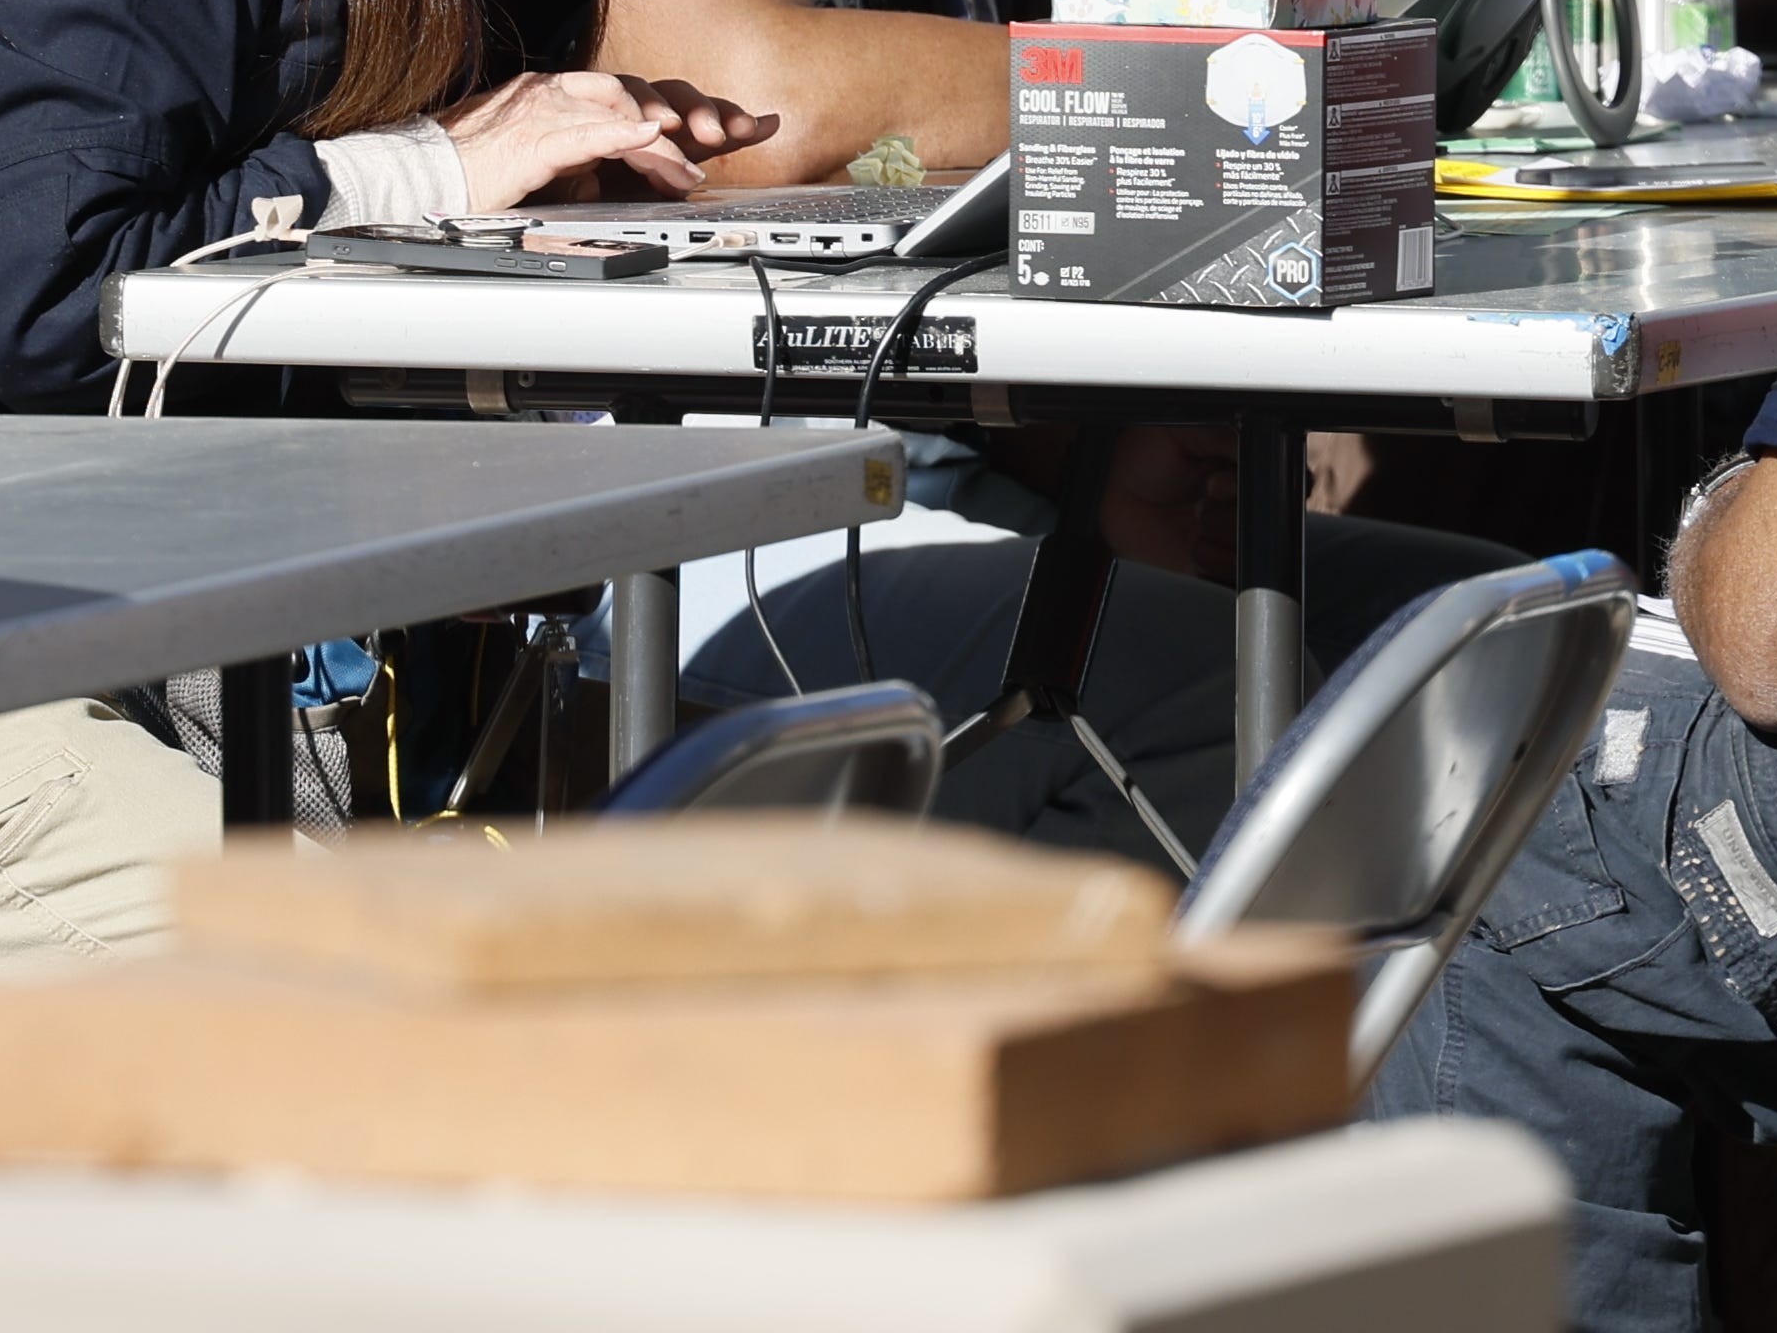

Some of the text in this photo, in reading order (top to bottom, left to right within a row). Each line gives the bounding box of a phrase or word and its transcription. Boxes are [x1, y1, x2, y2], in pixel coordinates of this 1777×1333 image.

[1019, 46, 1083, 84] 3M
[1019, 89, 1061, 113] COOL
[1064, 90, 1110, 115] FLOW
[1019, 115, 1166, 129] RESPIRATOR RESPIRATEUR RESPIRADOR
[1018, 142, 1096, 156] Sanding & Fiberglass
[1216, 149, 1300, 160] Lijado y fibra de vidrio
[1025, 155, 1054, 165] Breathe
[1055, 156, 1070, 165] 30%
[1223, 160, 1251, 171] Respire
[1263, 162, 1275, 171] 30
[1116, 167, 1148, 177] Respirez
[1149, 168, 1160, 177] 30
[1223, 170, 1240, 180] más
[1116, 177, 1132, 187] plus
[1023, 213, 1090, 230] 8511 N95
[1018, 239, 1045, 253] CONT:
[1018, 254, 1084, 285] 5 P2
[1276, 259, 1309, 284] PRO
[896, 329, 972, 351] ABLES
